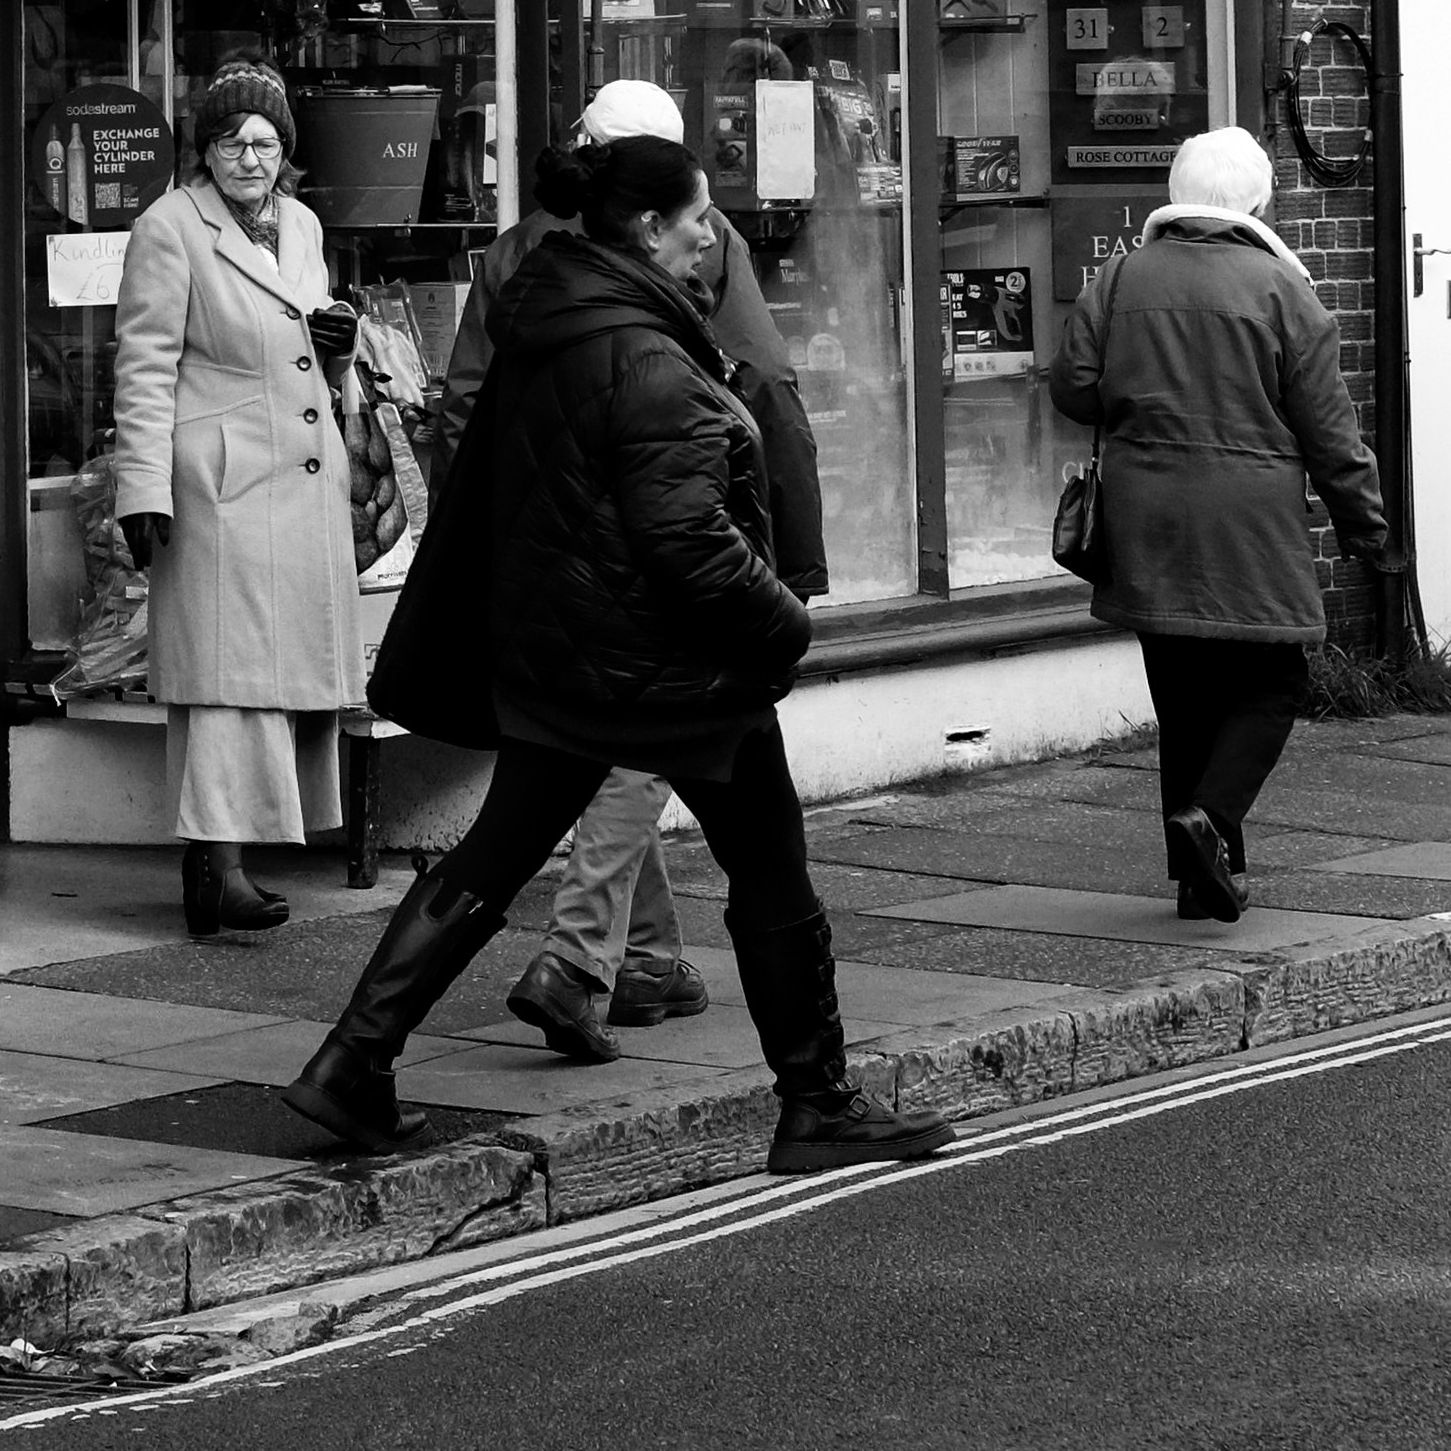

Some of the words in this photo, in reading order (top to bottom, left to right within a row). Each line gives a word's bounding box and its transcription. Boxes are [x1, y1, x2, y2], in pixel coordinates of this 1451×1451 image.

[1073, 18, 1100, 39] 31
[1156, 16, 1169, 38] 2
[1092, 71, 1158, 88] BELLA
[1097, 113, 1152, 126] SCOOBY
[93, 127, 160, 141] EXCHANGE
[93, 140, 129, 152] YOUR
[381, 142, 419, 159] ASH
[94, 150, 156, 163] CYLINDER
[1076, 151, 1112, 163] ROSE
[94, 163, 127, 174] HERE
[1123, 206, 1134, 228] 1
[52, 237, 125, 264] Kindlin
[1092, 235, 1144, 258] EAS
[75, 271, 110, 301] £6
